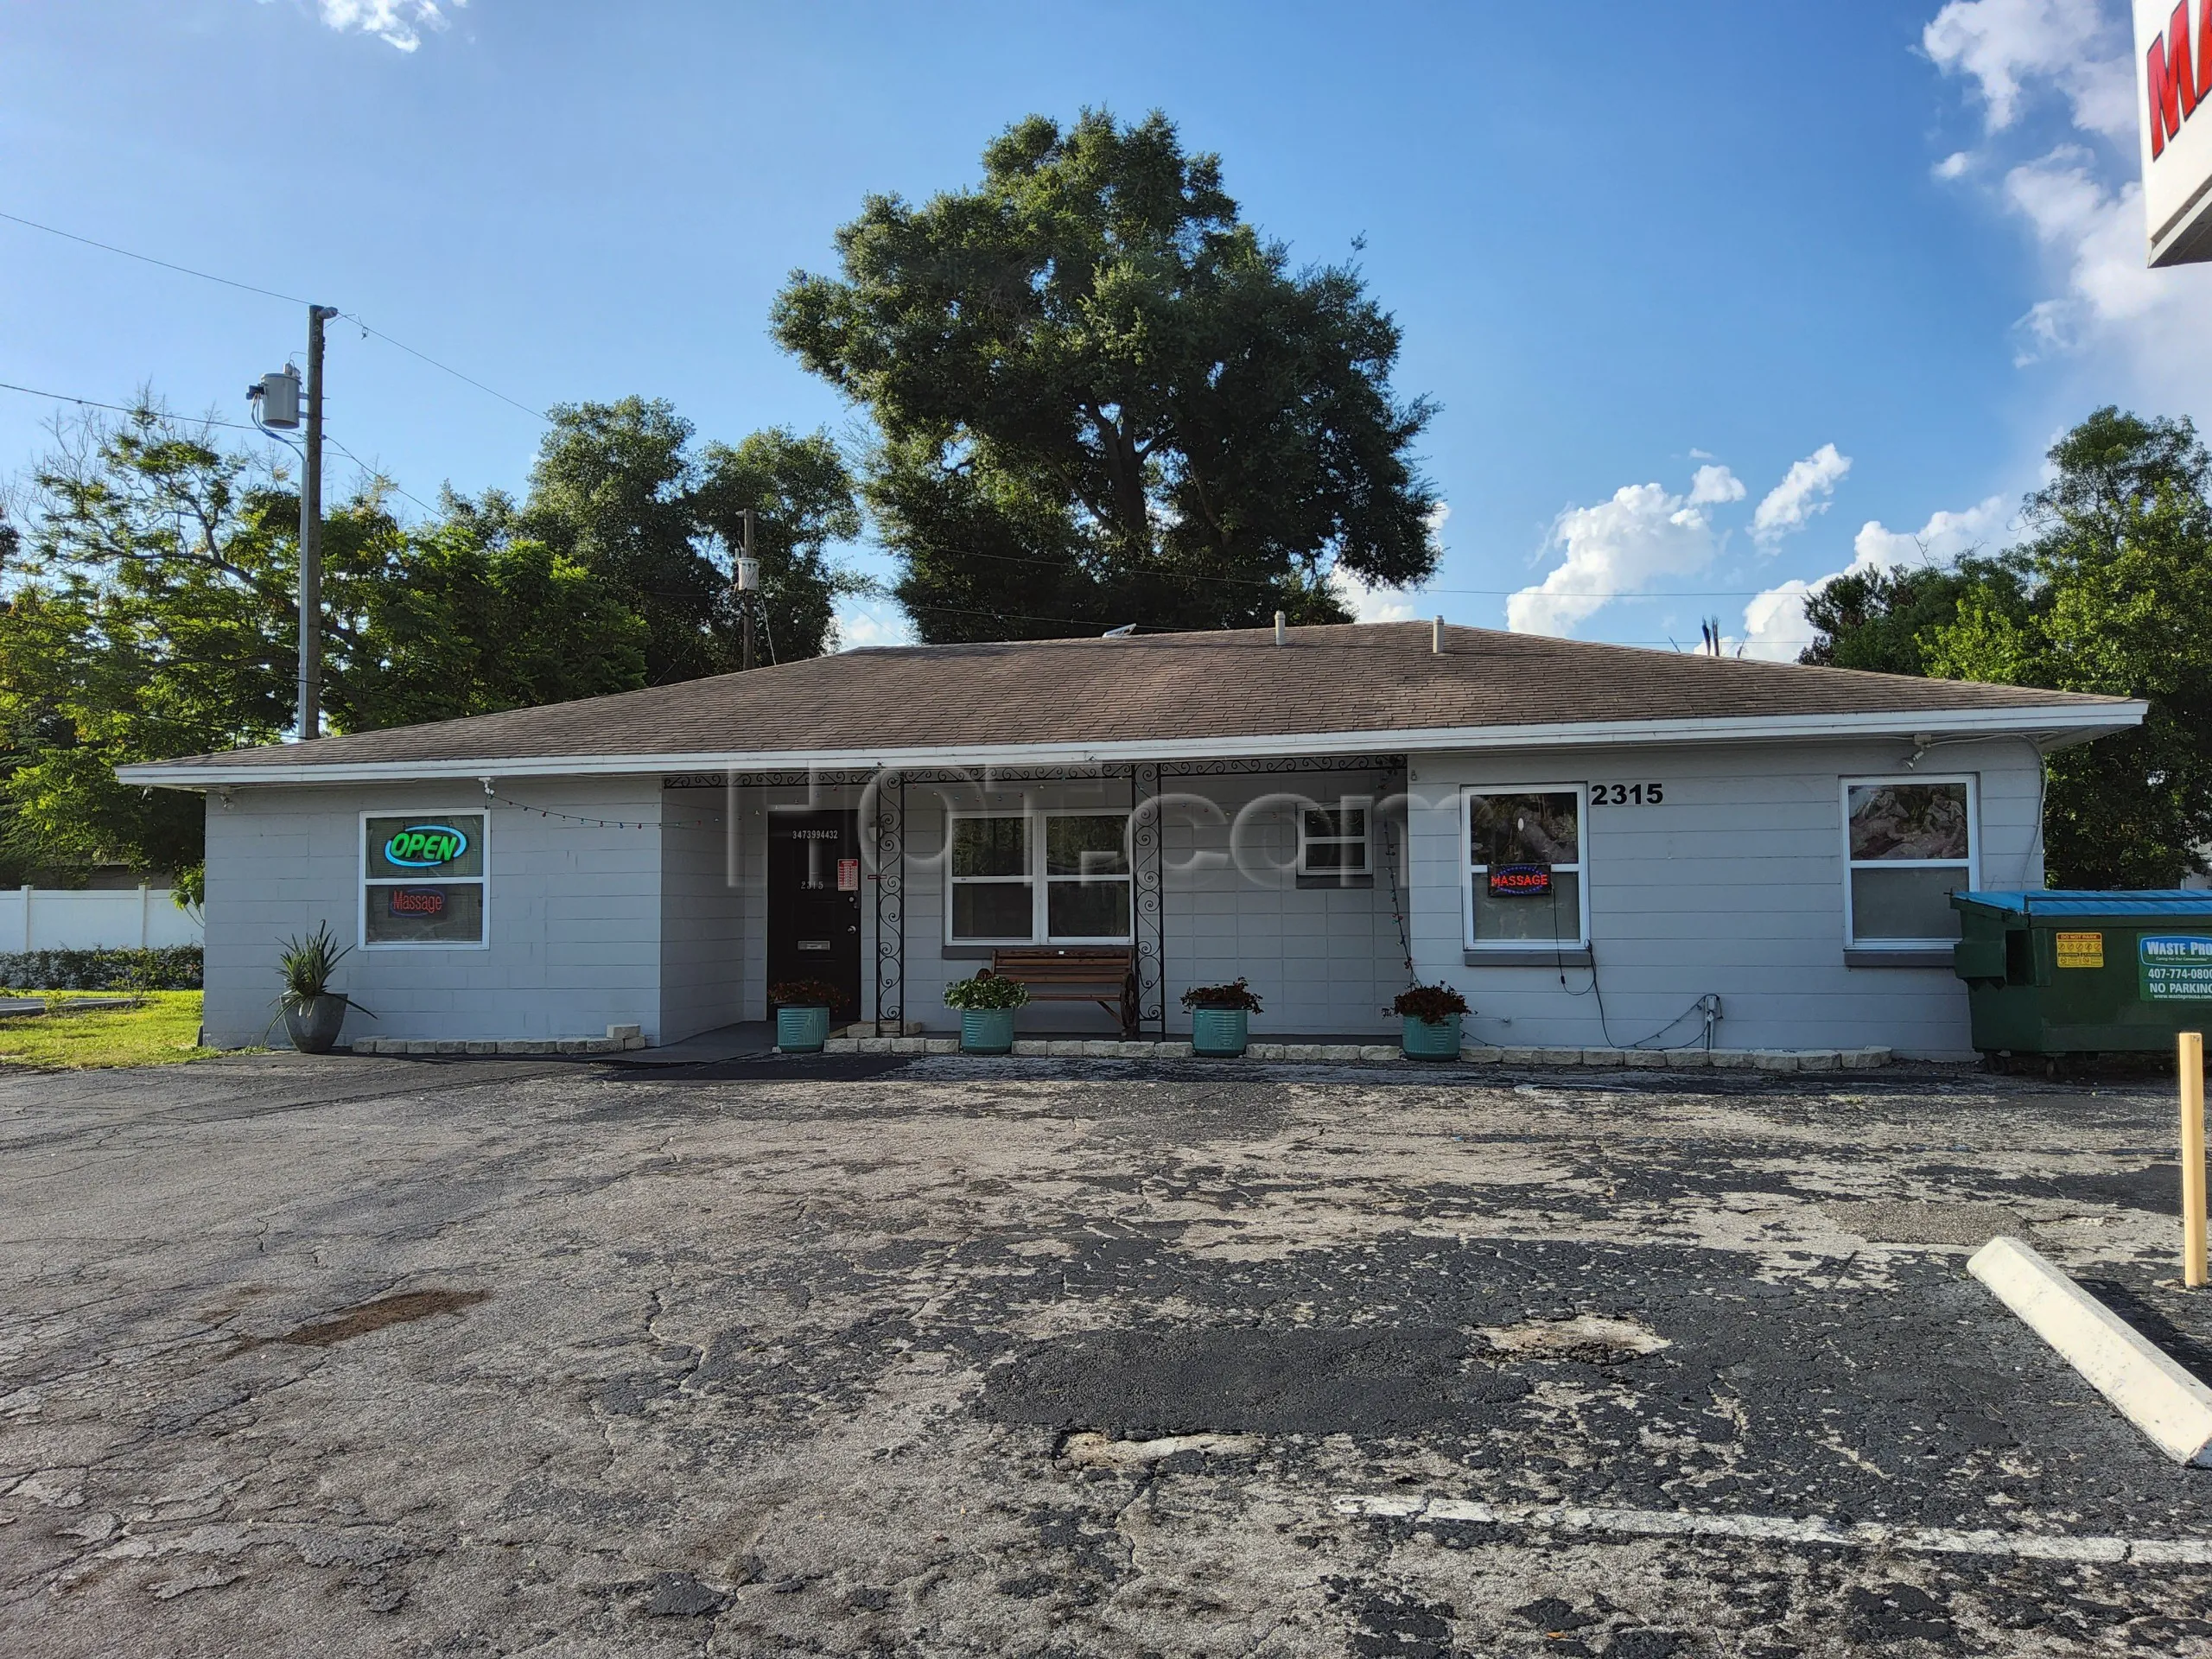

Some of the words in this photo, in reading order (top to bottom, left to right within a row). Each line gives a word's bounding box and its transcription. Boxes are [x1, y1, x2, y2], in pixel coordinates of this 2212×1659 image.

[1591, 783, 1664, 805] 2315
[792, 830, 838, 839] 3473994432
[391, 832, 459, 861] OPEN
[800, 880, 824, 890] 2315
[1491, 874, 1548, 887] MASSAGE
[393, 890, 443, 914] Massage
[2146, 941, 2186, 955] WASTE
[2149, 982, 2166, 993] NO
